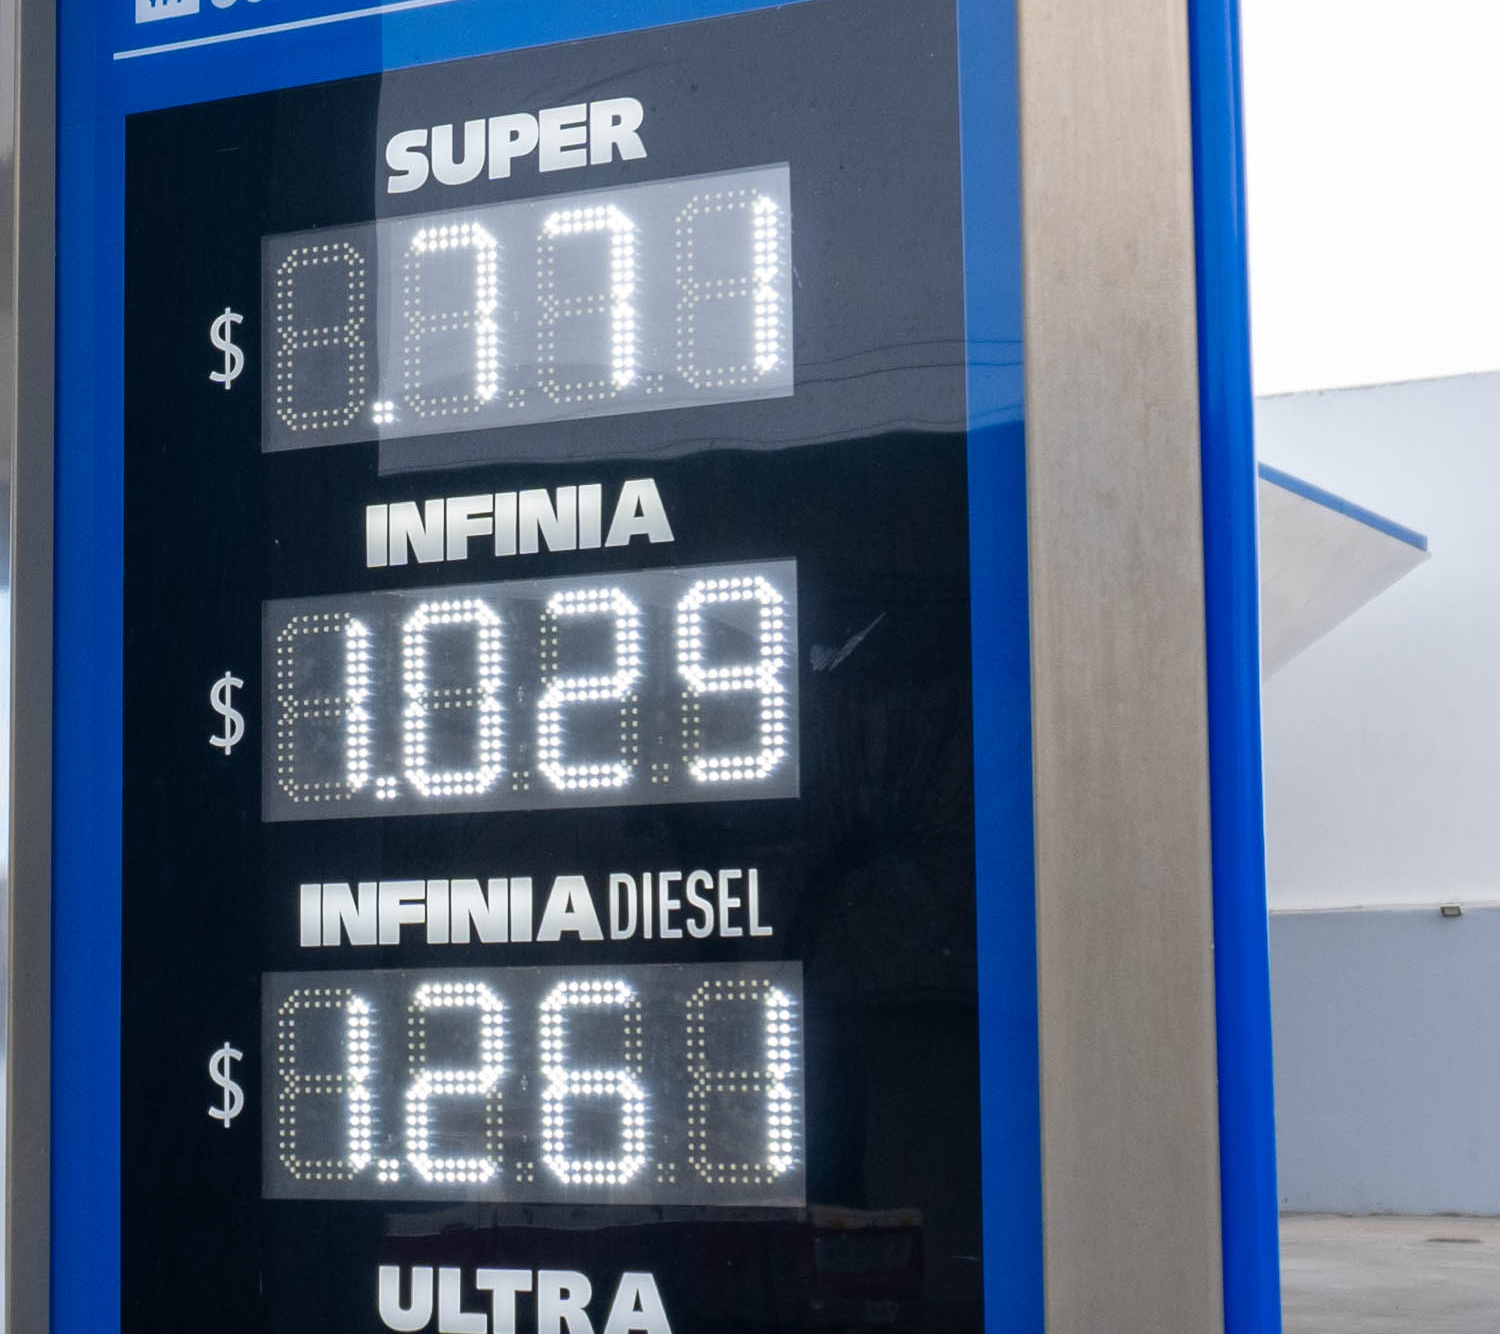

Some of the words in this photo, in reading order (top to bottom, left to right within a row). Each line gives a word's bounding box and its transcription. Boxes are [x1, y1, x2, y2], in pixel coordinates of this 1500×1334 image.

[385, 97, 648, 194] SUPER
[208, 306, 246, 390] $
[365, 477, 676, 569] INFINIA
[208, 670, 246, 756] $
[344, 575, 786, 799] 1.029
[299, 874, 604, 948] INFINIA
[608, 867, 774, 940] DIESEL
[207, 1041, 245, 1129] $
[347, 979, 793, 1186] 1.261
